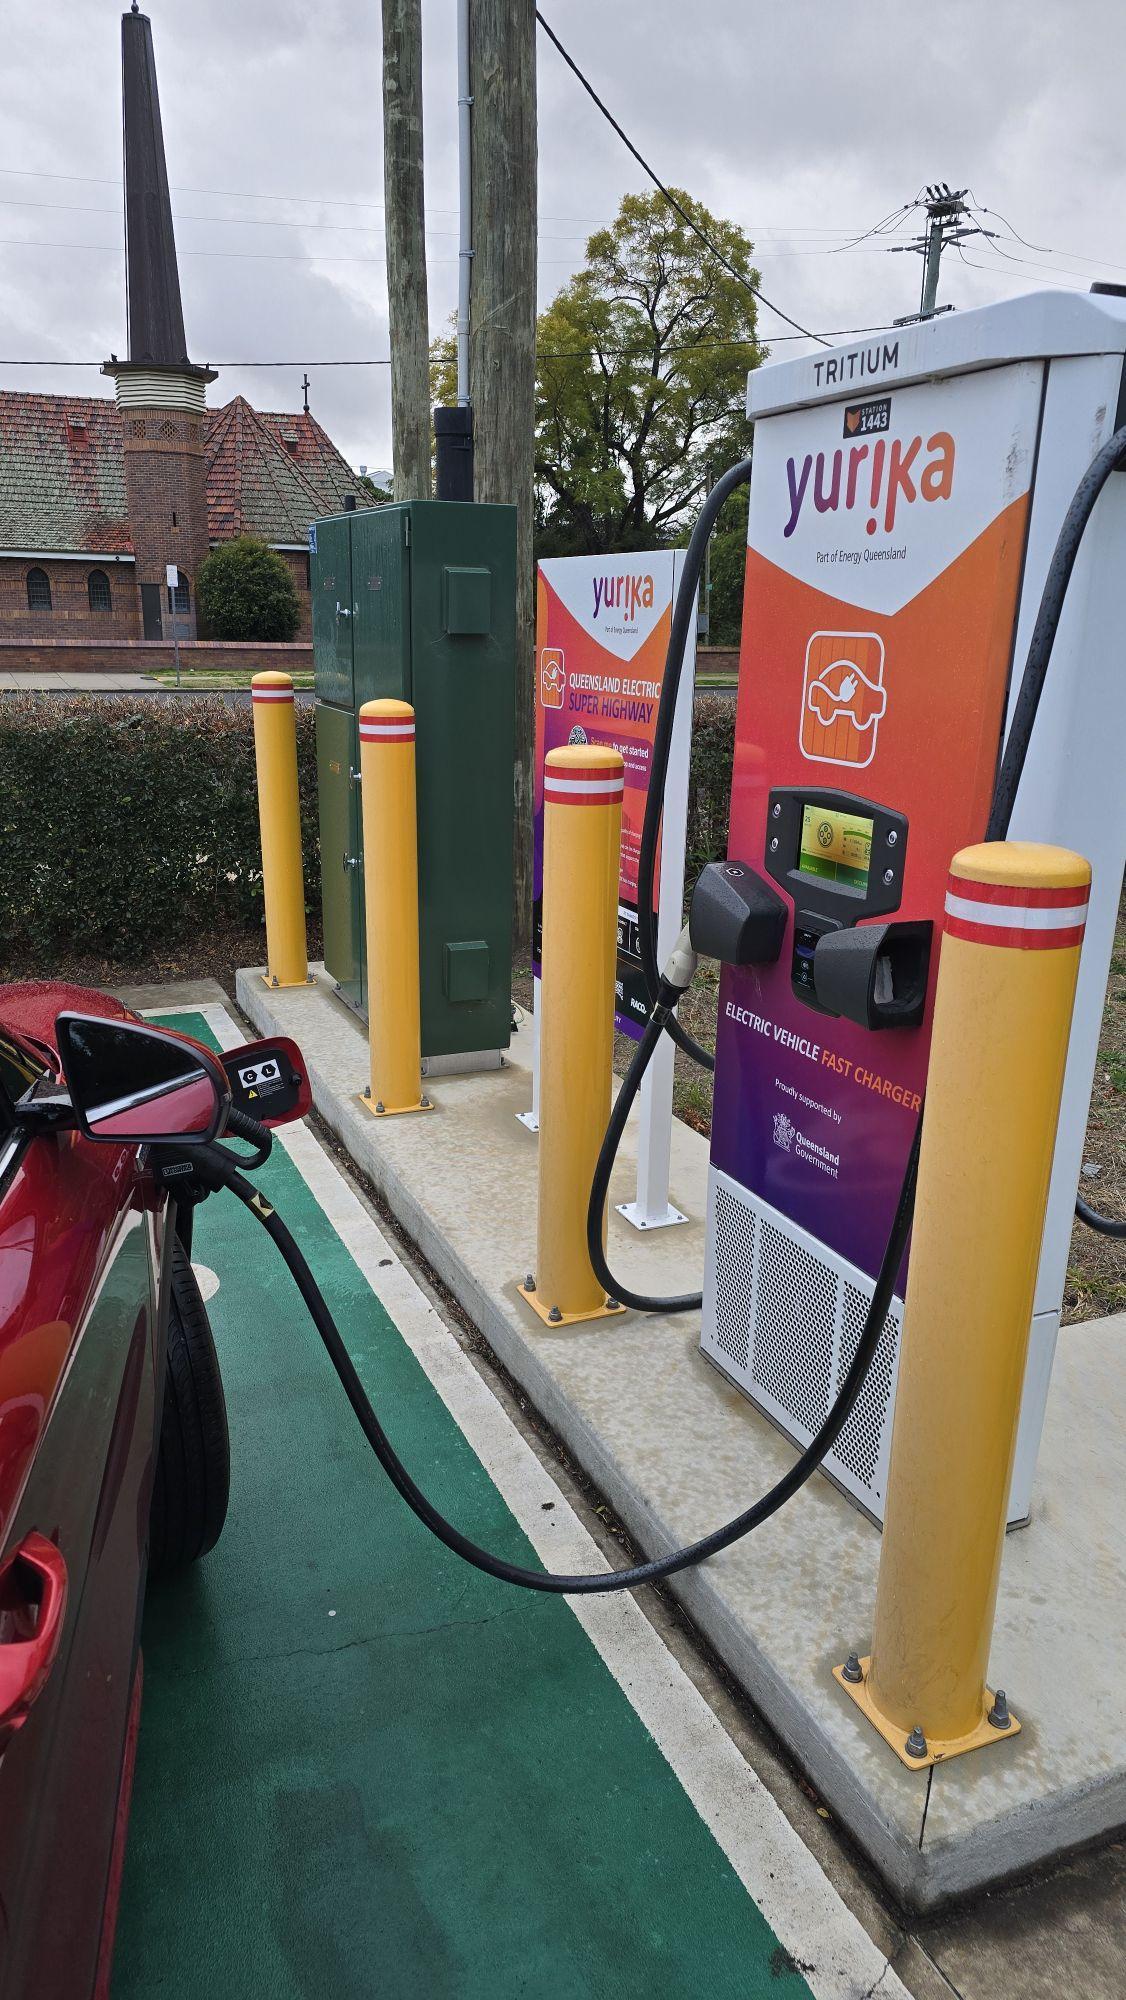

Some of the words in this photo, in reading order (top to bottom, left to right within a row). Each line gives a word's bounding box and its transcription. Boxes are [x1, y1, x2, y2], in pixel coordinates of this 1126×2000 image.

[814, 342, 899, 387] TRITIUM
[860, 411, 888, 432] 1443
[861, 403, 888, 416] STATION
[816, 551, 831, 563] Part
[831, 549, 839, 562] of
[839, 549, 862, 565] Energy
[863, 545, 907, 562] Queensland
[569, 671, 620, 694] QUEENSLAND
[622, 679, 661, 699] ELECTRIC
[568, 691, 598, 715] SUPER
[601, 698, 655, 724] HIGHWAY
[612, 742, 619, 750] to
[619, 744, 629, 755] get
[629, 746, 649, 759] started
[725, 1001, 772, 1036] ELECTRIC
[774, 1024, 820, 1061] VEHICLE
[821, 1049, 852, 1077] FAST
[854, 1066, 922, 1113] CHARGER
[775, 1078, 799, 1100] Proudly
[799, 1091, 833, 1118] supported
[833, 1112, 842, 1125] by
[795, 1144, 839, 1179] Government
[796, 1132, 840, 1166] Queensland
